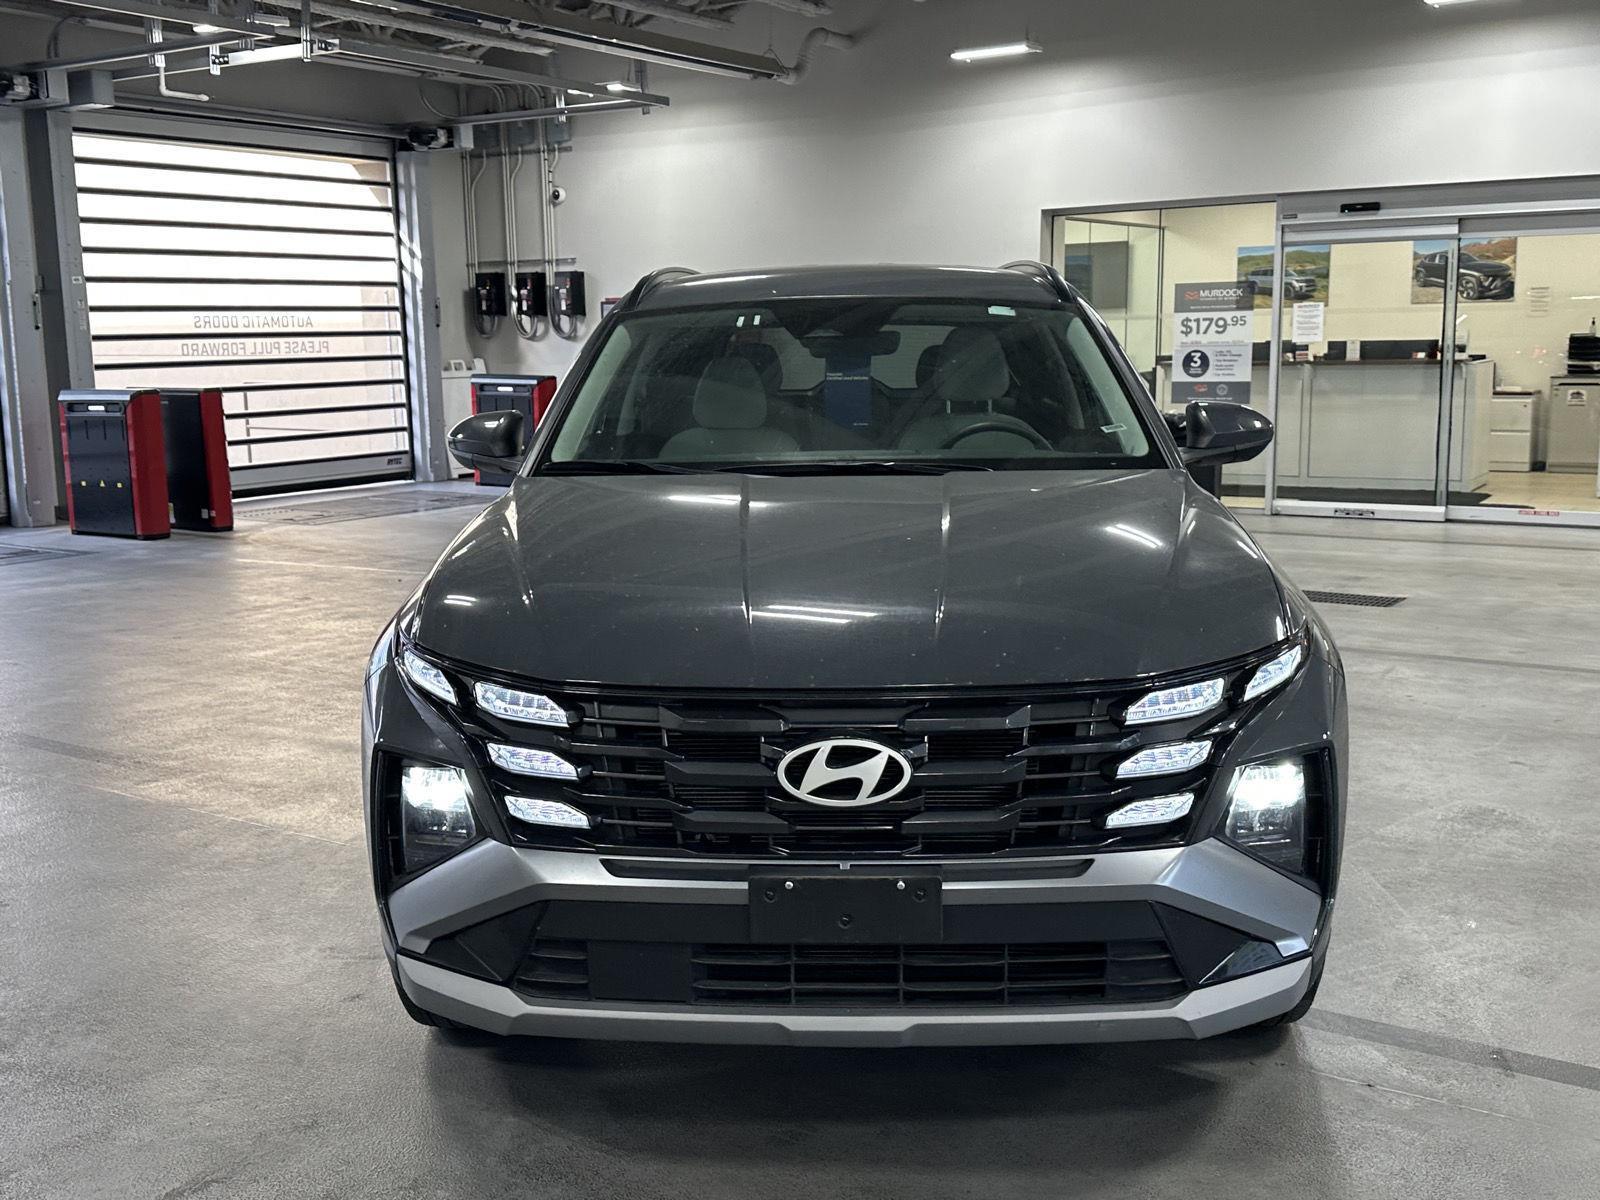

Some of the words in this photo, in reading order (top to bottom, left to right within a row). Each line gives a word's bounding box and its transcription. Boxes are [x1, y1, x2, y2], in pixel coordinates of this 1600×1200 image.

[1200, 288, 1243, 297] MURDOCK
[1180, 315, 1247, 337] $179.95
[1190, 352, 1202, 367] 3
